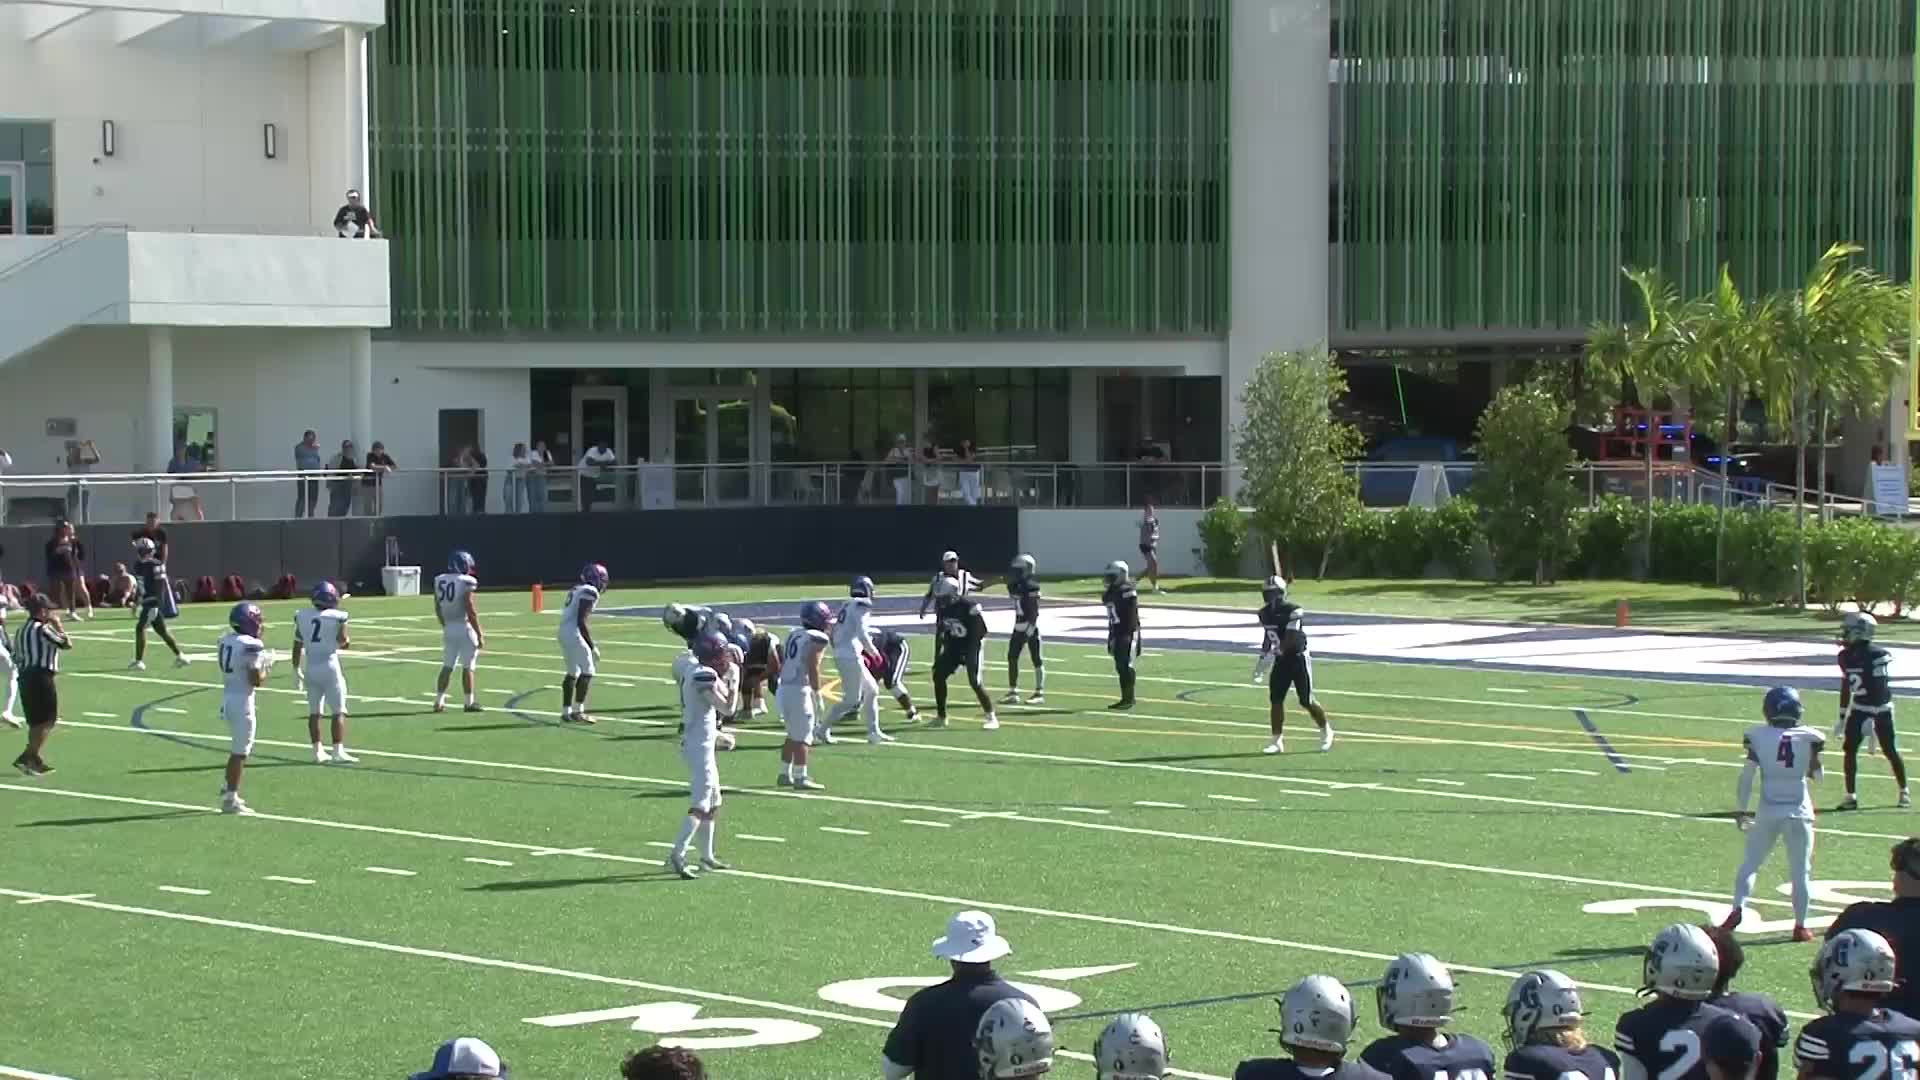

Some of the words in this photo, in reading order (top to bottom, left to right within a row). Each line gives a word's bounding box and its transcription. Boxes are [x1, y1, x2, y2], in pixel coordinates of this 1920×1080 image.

[438, 580, 455, 602] 50
[311, 618, 321, 642] 2
[1848, 674, 1868, 696] 2
[1776, 735, 1795, 768] 4
